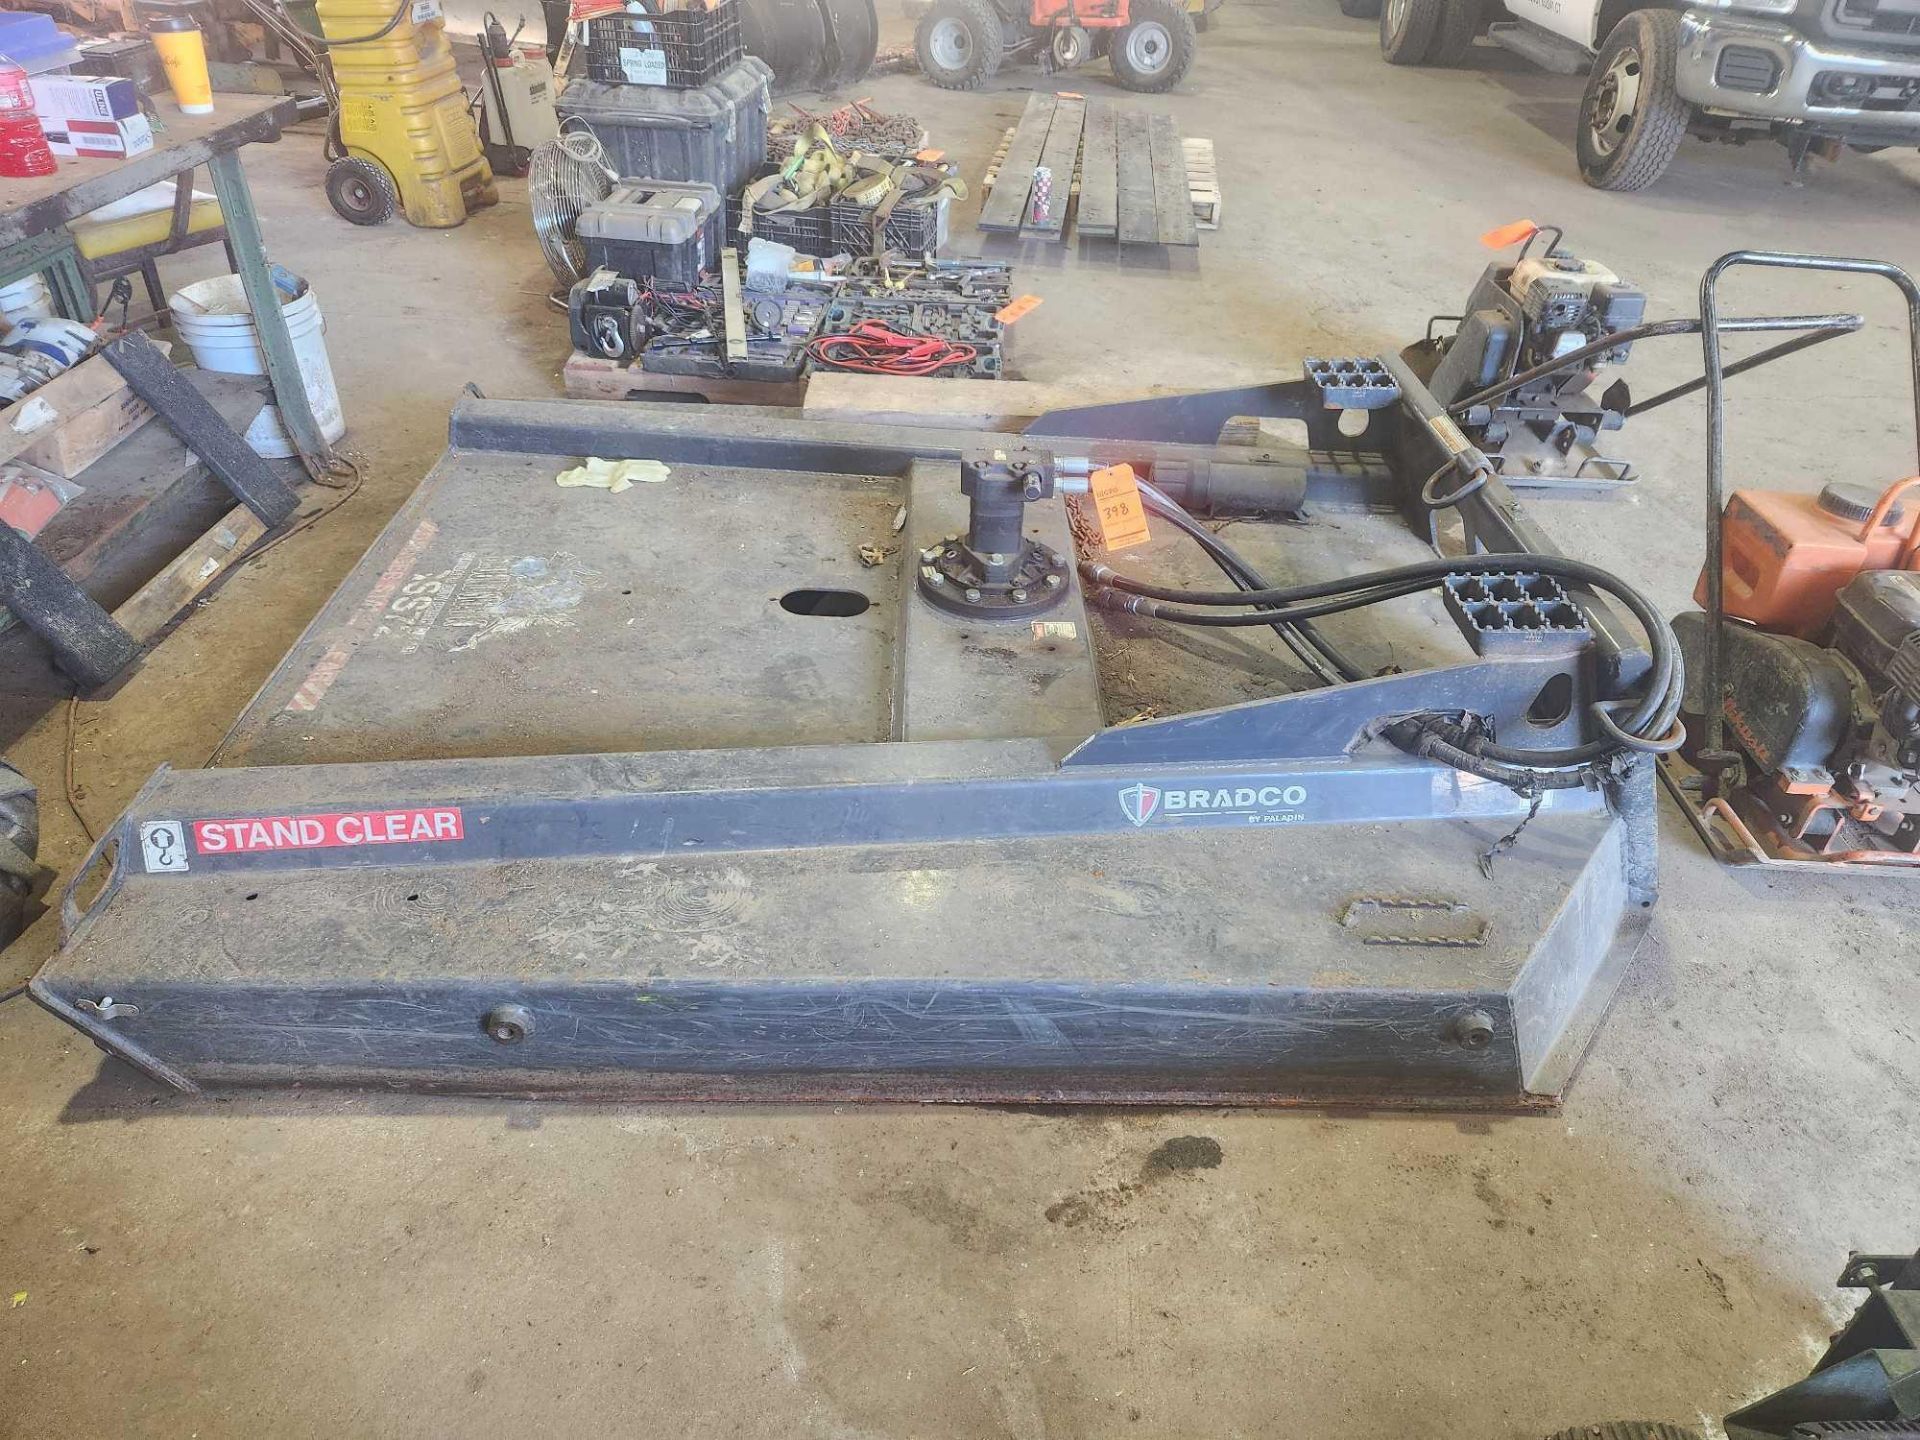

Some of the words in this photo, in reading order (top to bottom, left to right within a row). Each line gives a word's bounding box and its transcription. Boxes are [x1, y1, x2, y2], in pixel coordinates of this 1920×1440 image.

[1103, 502, 1129, 520] 398
[1163, 785, 1307, 810] BRADCO
[1248, 815, 1261, 823] BY
[1263, 813, 1305, 823] PALADIN
[201, 820, 326, 851] STAND
[335, 811, 458, 845] CLEAR
